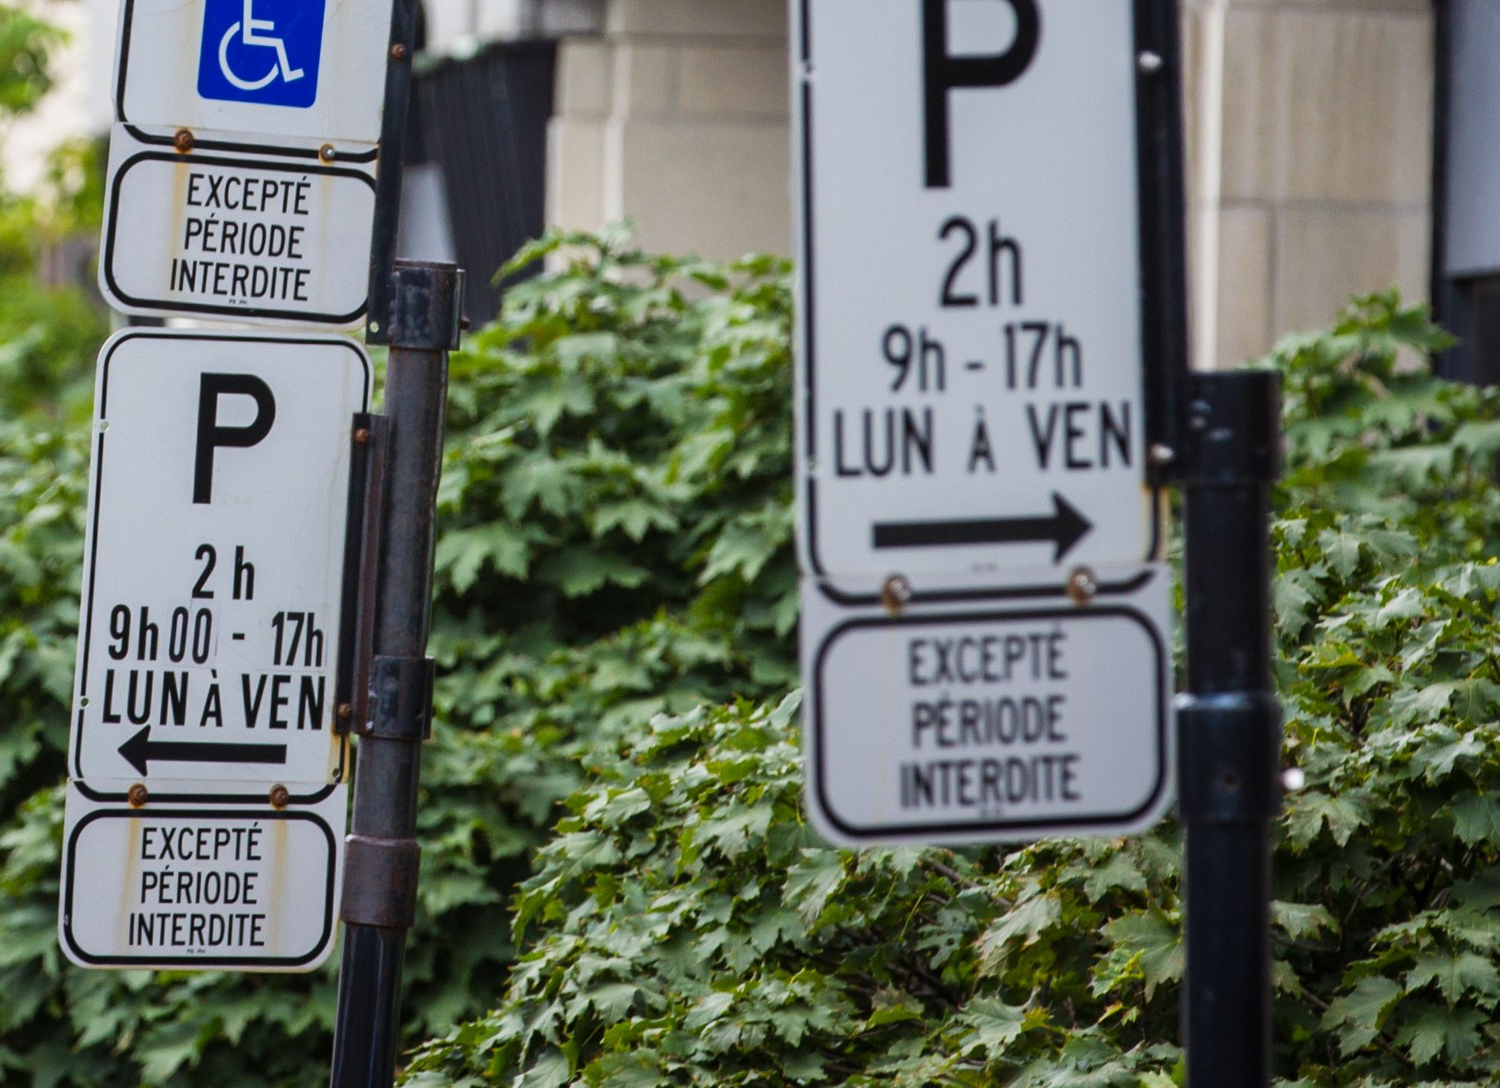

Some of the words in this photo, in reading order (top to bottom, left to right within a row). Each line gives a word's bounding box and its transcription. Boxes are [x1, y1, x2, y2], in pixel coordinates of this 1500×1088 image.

[186, 173, 312, 215] EXCEPTÉ
[184, 213, 305, 259] PÉRIODE
[936, 215, 1022, 309] 2h
[170, 258, 310, 301] INTERDITE
[881, 324, 945, 393] 9h
[1004, 321, 1083, 389] 17h
[192, 372, 276, 504] P
[833, 405, 933, 478] LUN
[968, 405, 996, 474] À
[1026, 400, 1133, 472] VEN
[108, 603, 214, 665] 9h00
[271, 611, 324, 667] 17h
[908, 620, 1068, 687] EXCEPTÉ
[102, 669, 189, 727] LUN
[200, 669, 223, 728] À
[241, 674, 326, 731] VEN
[911, 687, 1067, 751] PÉRIODE
[899, 754, 1081, 810] INTERDITE
[140, 822, 262, 862] EXCEPTÉ
[140, 864, 259, 905] PÉRIODE
[128, 912, 266, 947] INTERDITE
